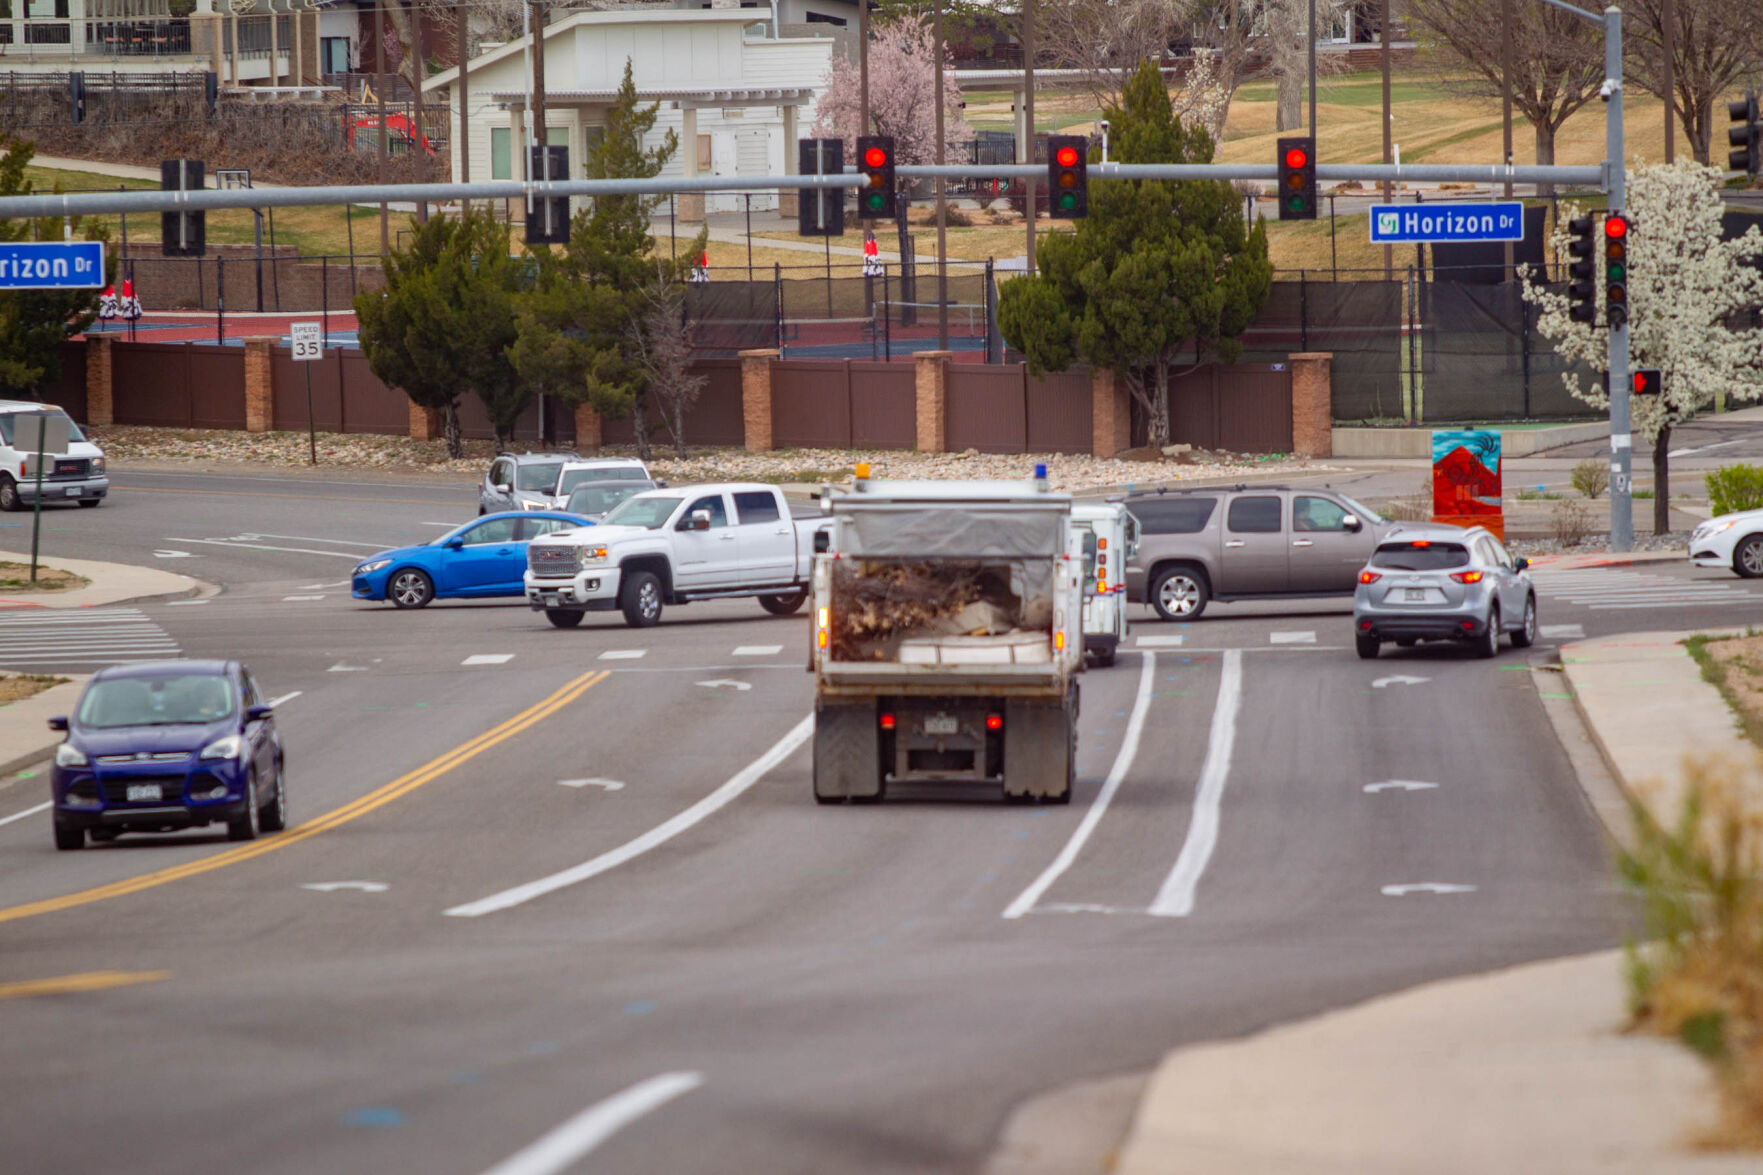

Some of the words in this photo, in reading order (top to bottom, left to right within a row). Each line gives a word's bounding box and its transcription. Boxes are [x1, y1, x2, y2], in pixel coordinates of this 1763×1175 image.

[1405, 212, 1494, 234] Horizon
[1499, 214, 1514, 229] Dr
[0, 253, 69, 278] rizon
[75, 256, 92, 272] Dr
[296, 342, 318, 356] 35
